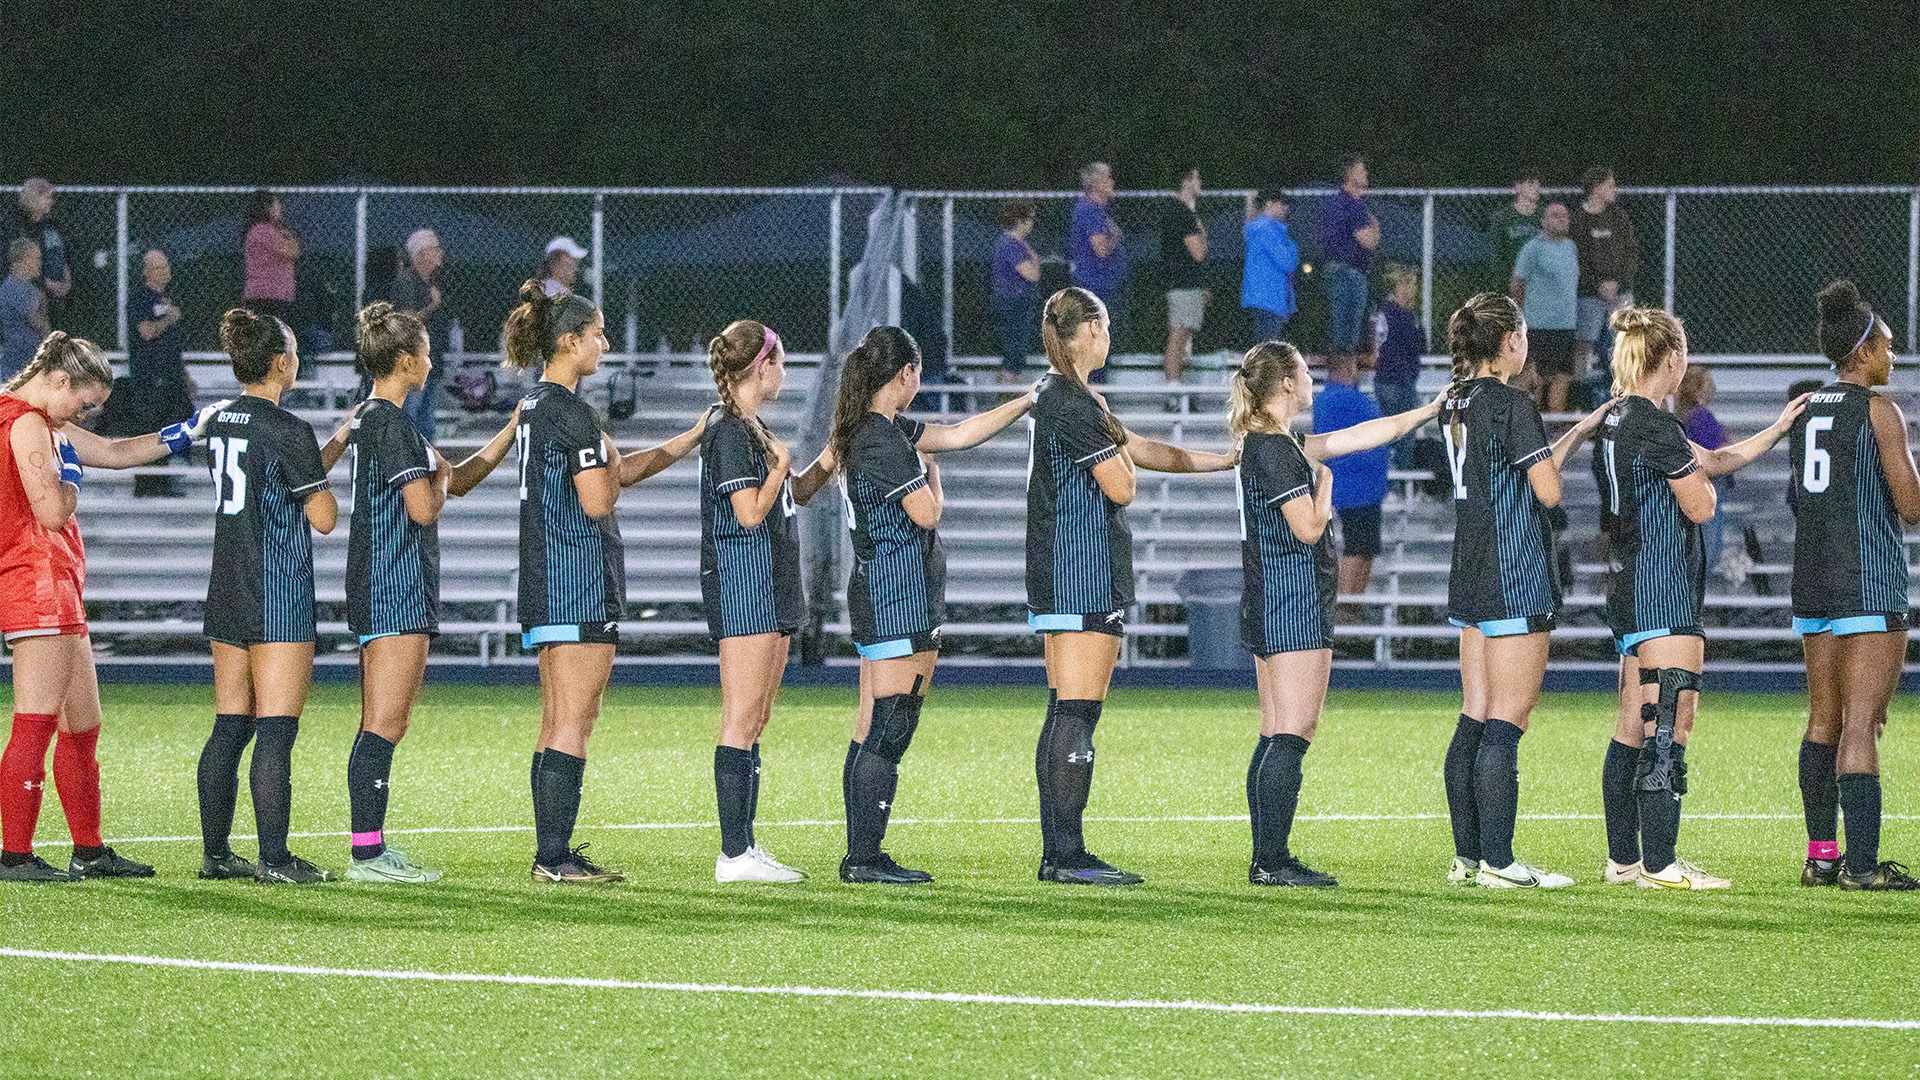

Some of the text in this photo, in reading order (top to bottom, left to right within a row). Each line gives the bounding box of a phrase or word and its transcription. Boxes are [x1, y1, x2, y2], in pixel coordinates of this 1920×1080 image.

[217, 411, 251, 425] OSPREYS
[578, 447, 597, 468] C
[1803, 416, 1834, 493] 6
